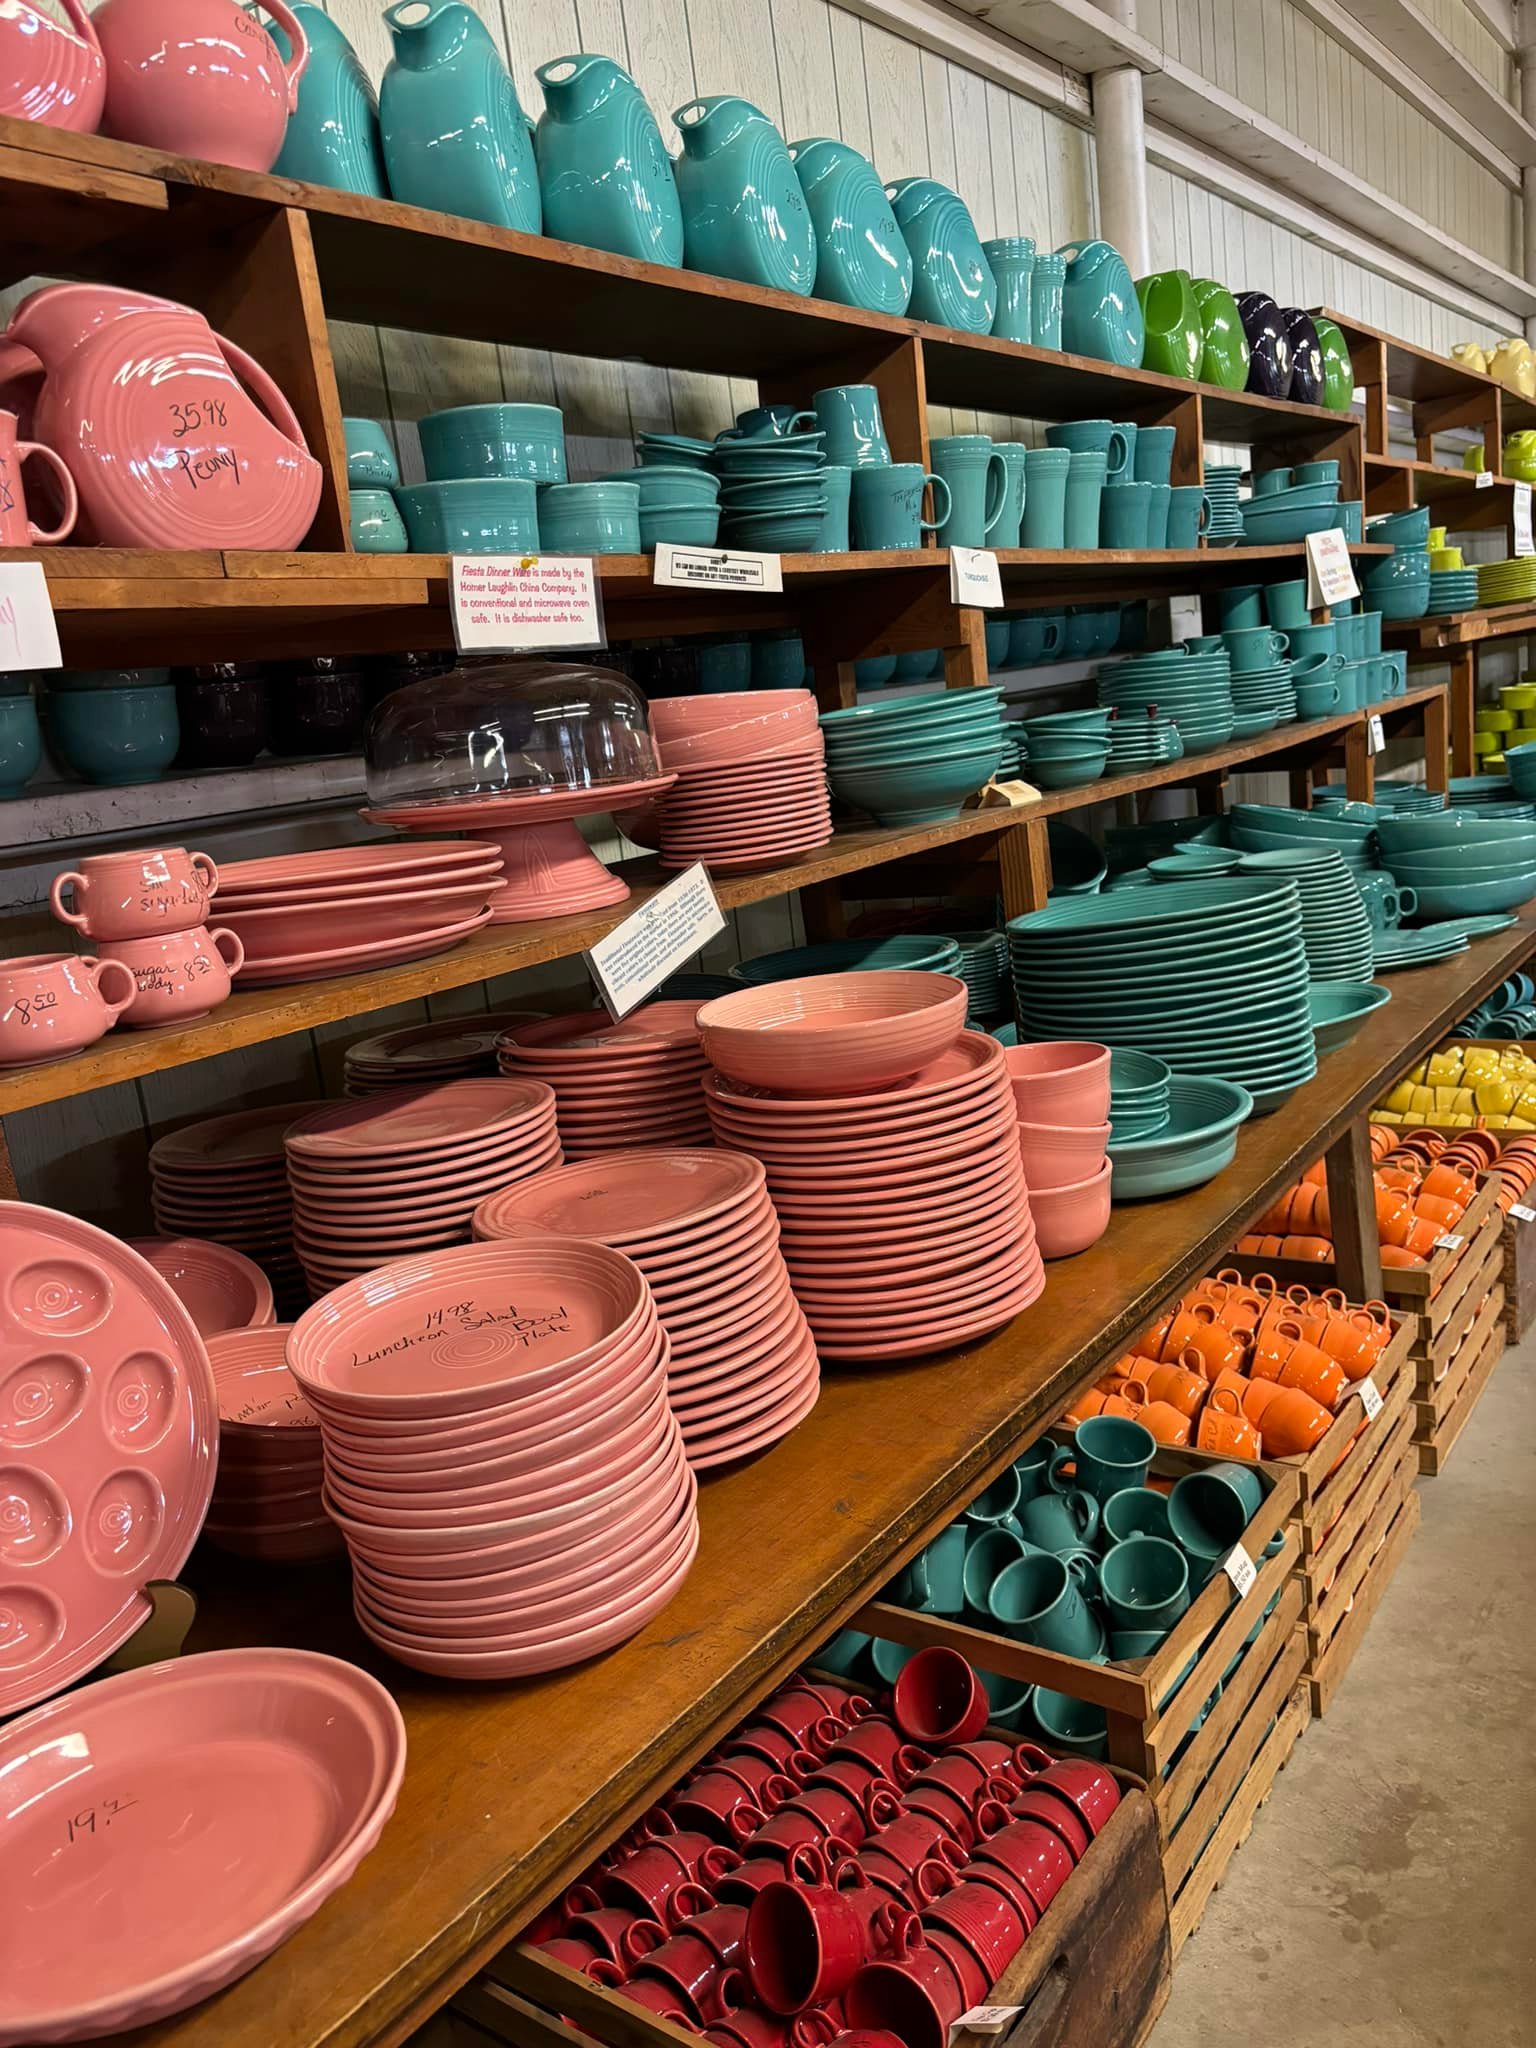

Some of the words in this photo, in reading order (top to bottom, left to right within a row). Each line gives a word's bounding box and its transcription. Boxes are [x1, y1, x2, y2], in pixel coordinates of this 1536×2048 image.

[462, 565, 484, 576] Fiesta
[486, 566, 510, 577] Dinner
[513, 567, 530, 577] Ware
[532, 568, 539, 577] is
[541, 568, 560, 577] made
[563, 568, 571, 580] by
[573, 568, 584, 578] the
[461, 582, 485, 591] Homer
[488, 582, 517, 594] Laughlin
[520, 583, 539, 592] China
[542, 583, 577, 595] Company.
[581, 583, 587, 592] It
[461, 598, 467, 607] is
[470, 598, 516, 607] conventional
[519, 598, 532, 607] and
[534, 599, 571, 607] microwave
[472, 614, 490, 623] safe.
[495, 614, 501, 623] It
[504, 614, 510, 623] is
[512, 613, 550, 623] dishwasher
[554, 613, 568, 622] safe
[570, 613, 584, 622] too.
[131, 965, 176, 984] sugar
[137, 979, 173, 996] body
[353, 1329, 449, 1367] Luncheon
[460, 1305, 517, 1331] Salad
[511, 1323, 572, 1347] Plate
